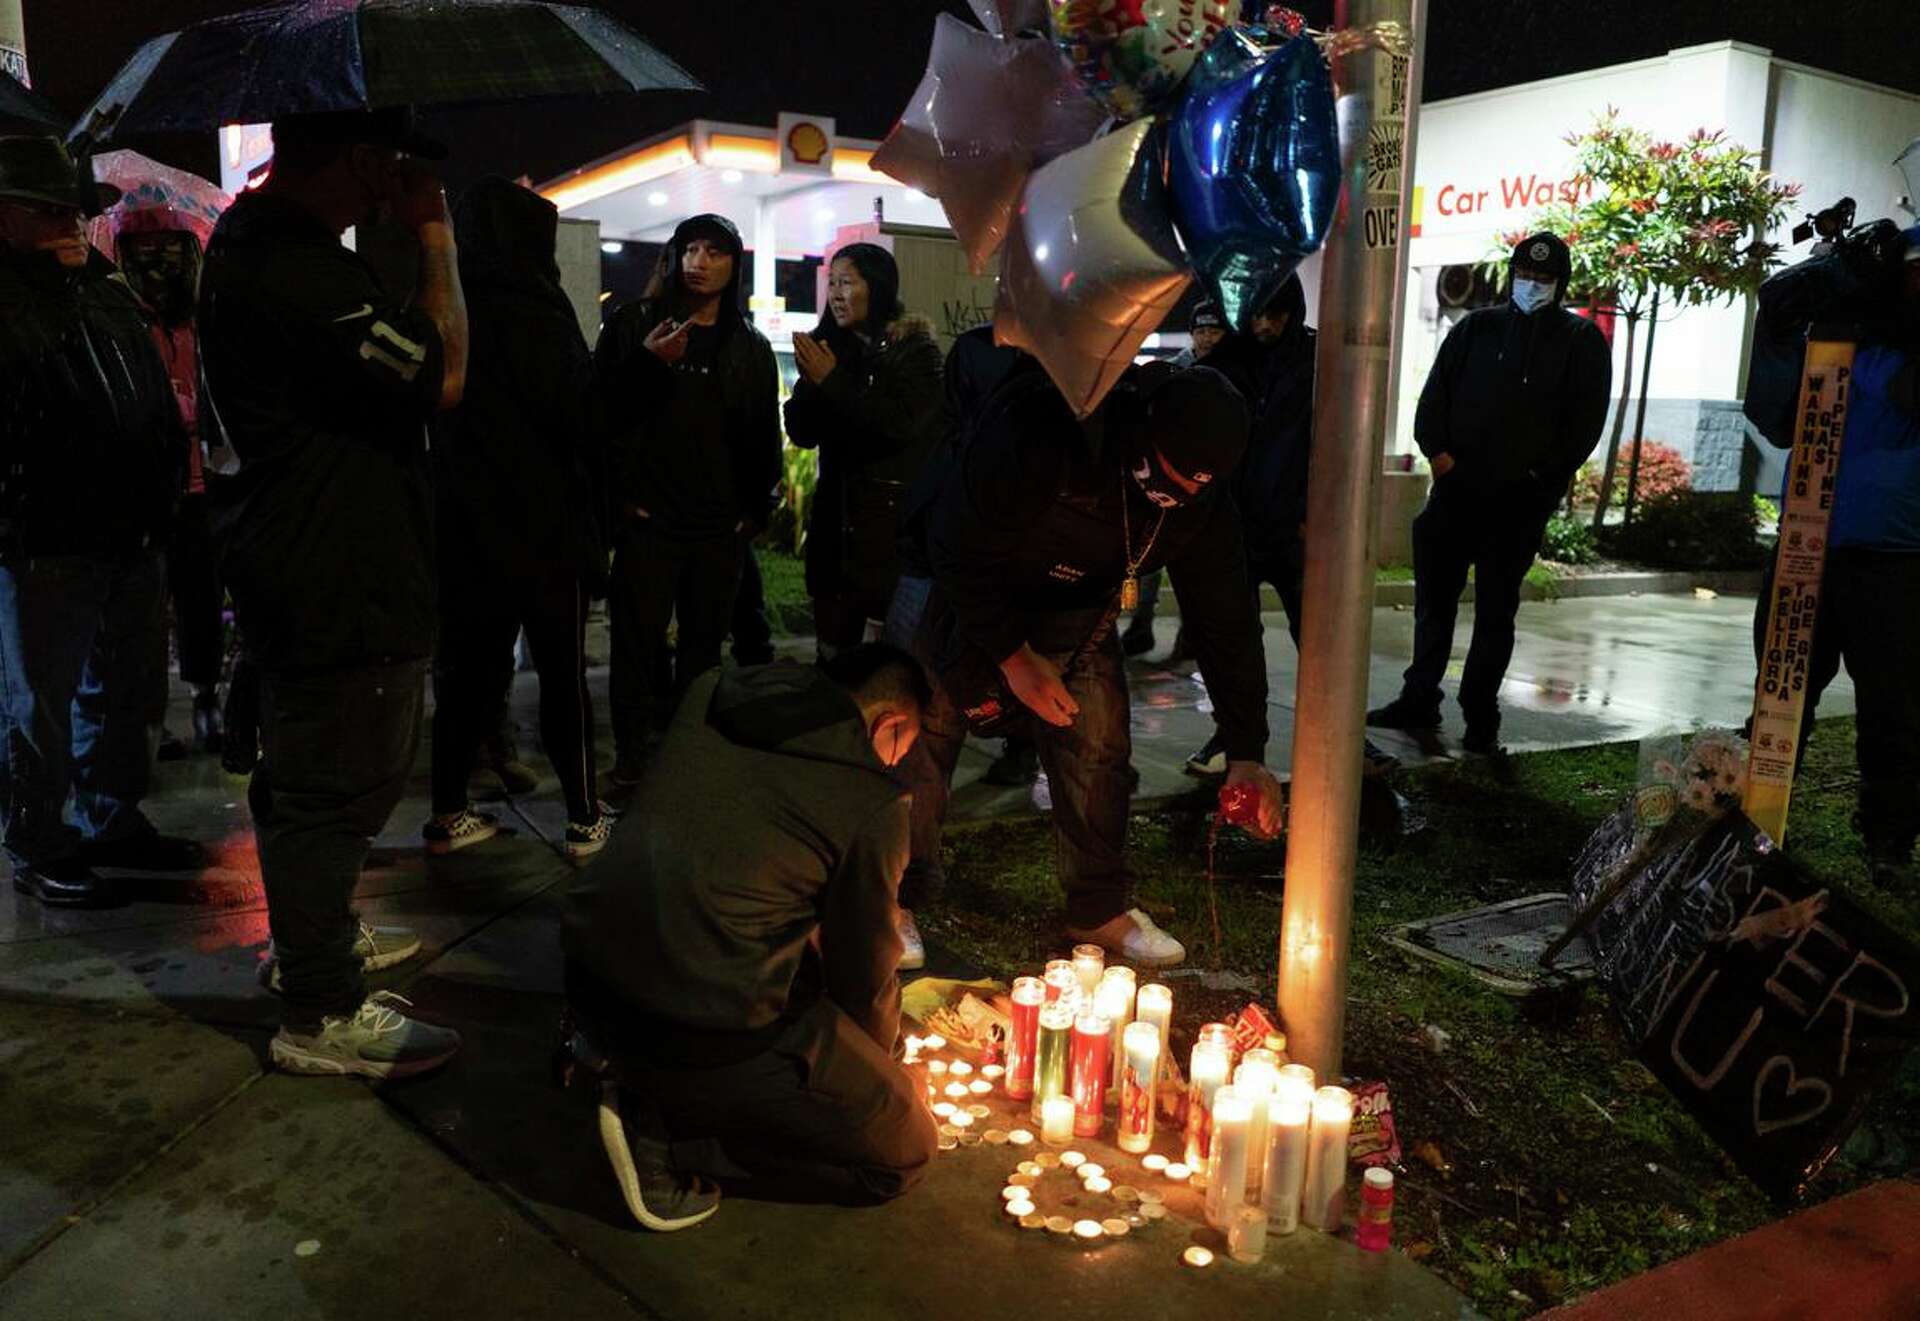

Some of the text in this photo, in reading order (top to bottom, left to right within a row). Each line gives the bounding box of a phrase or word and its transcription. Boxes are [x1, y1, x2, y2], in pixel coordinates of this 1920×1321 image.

[1437, 173, 1593, 216] Car Wash
[359, 320, 426, 382] 11
[1795, 376, 1825, 497] WARNING
[1814, 410, 1831, 466] GAS
[1819, 366, 1850, 510] PIPELINE
[1764, 586, 1791, 694] PELIGRO
[1801, 595, 1816, 628] DE
[1791, 640, 1808, 691] GAS
